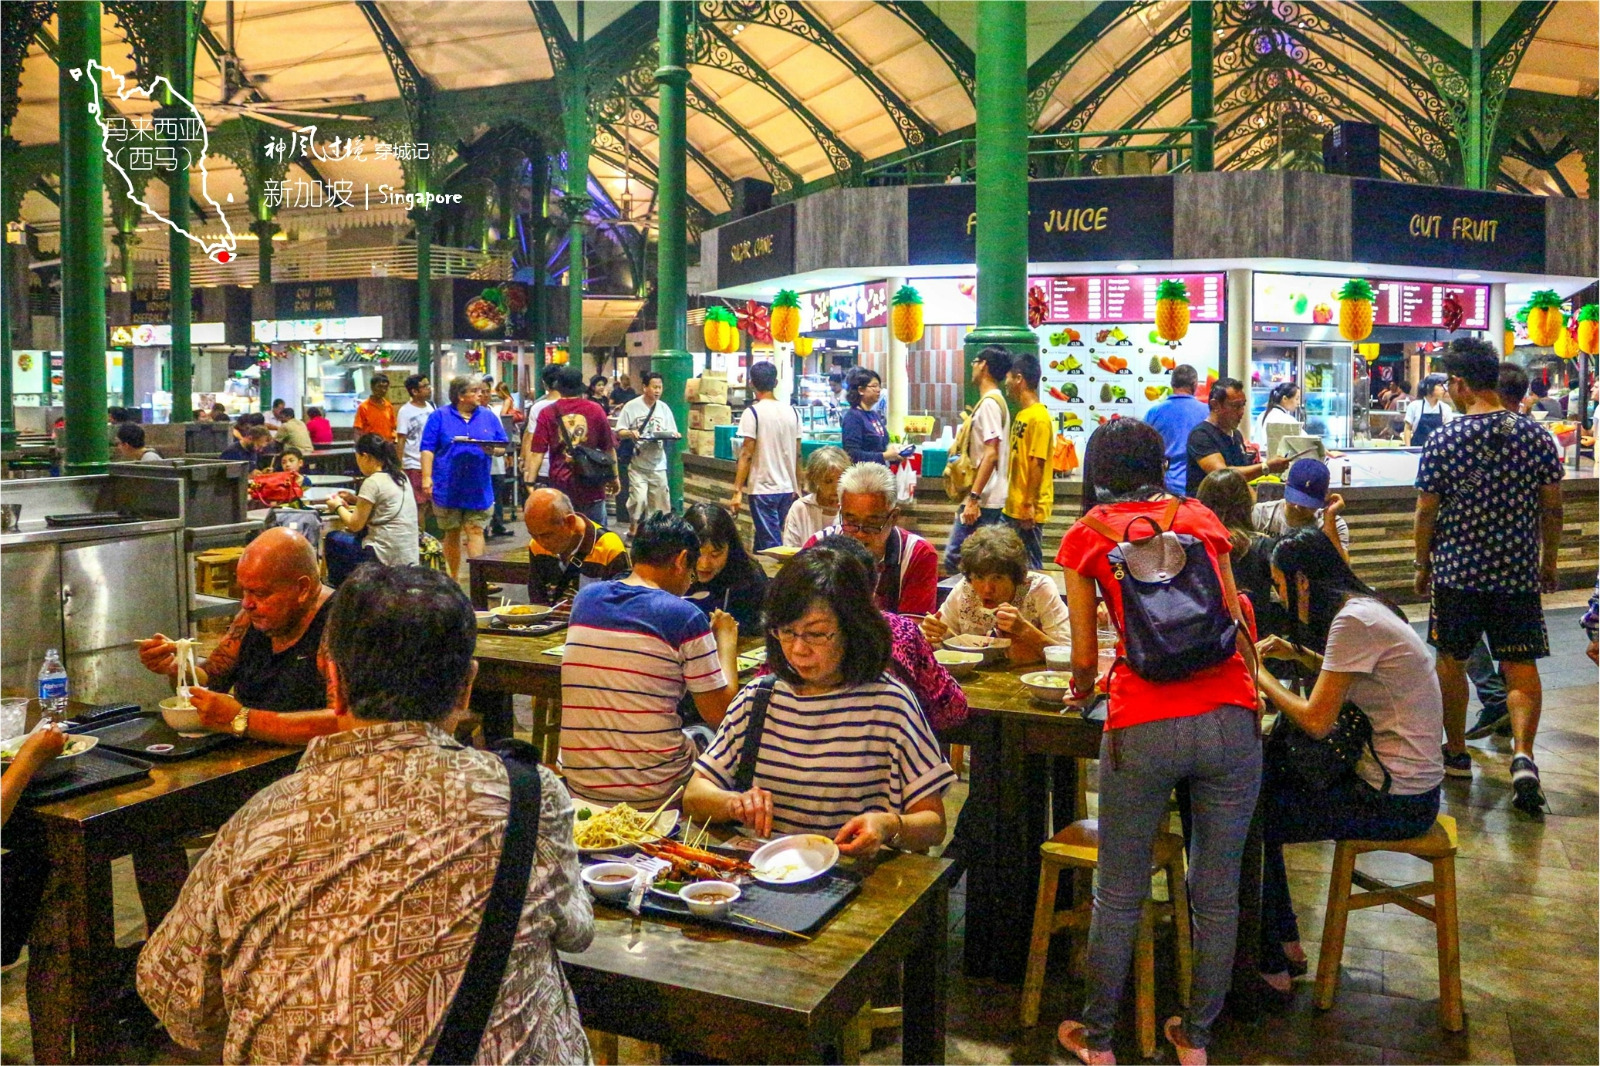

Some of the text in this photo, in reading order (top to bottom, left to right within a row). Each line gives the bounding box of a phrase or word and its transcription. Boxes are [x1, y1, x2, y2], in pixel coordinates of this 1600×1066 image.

[1044, 207, 1109, 232] JUICE
[1409, 213, 1499, 242] CUT FRUIT
